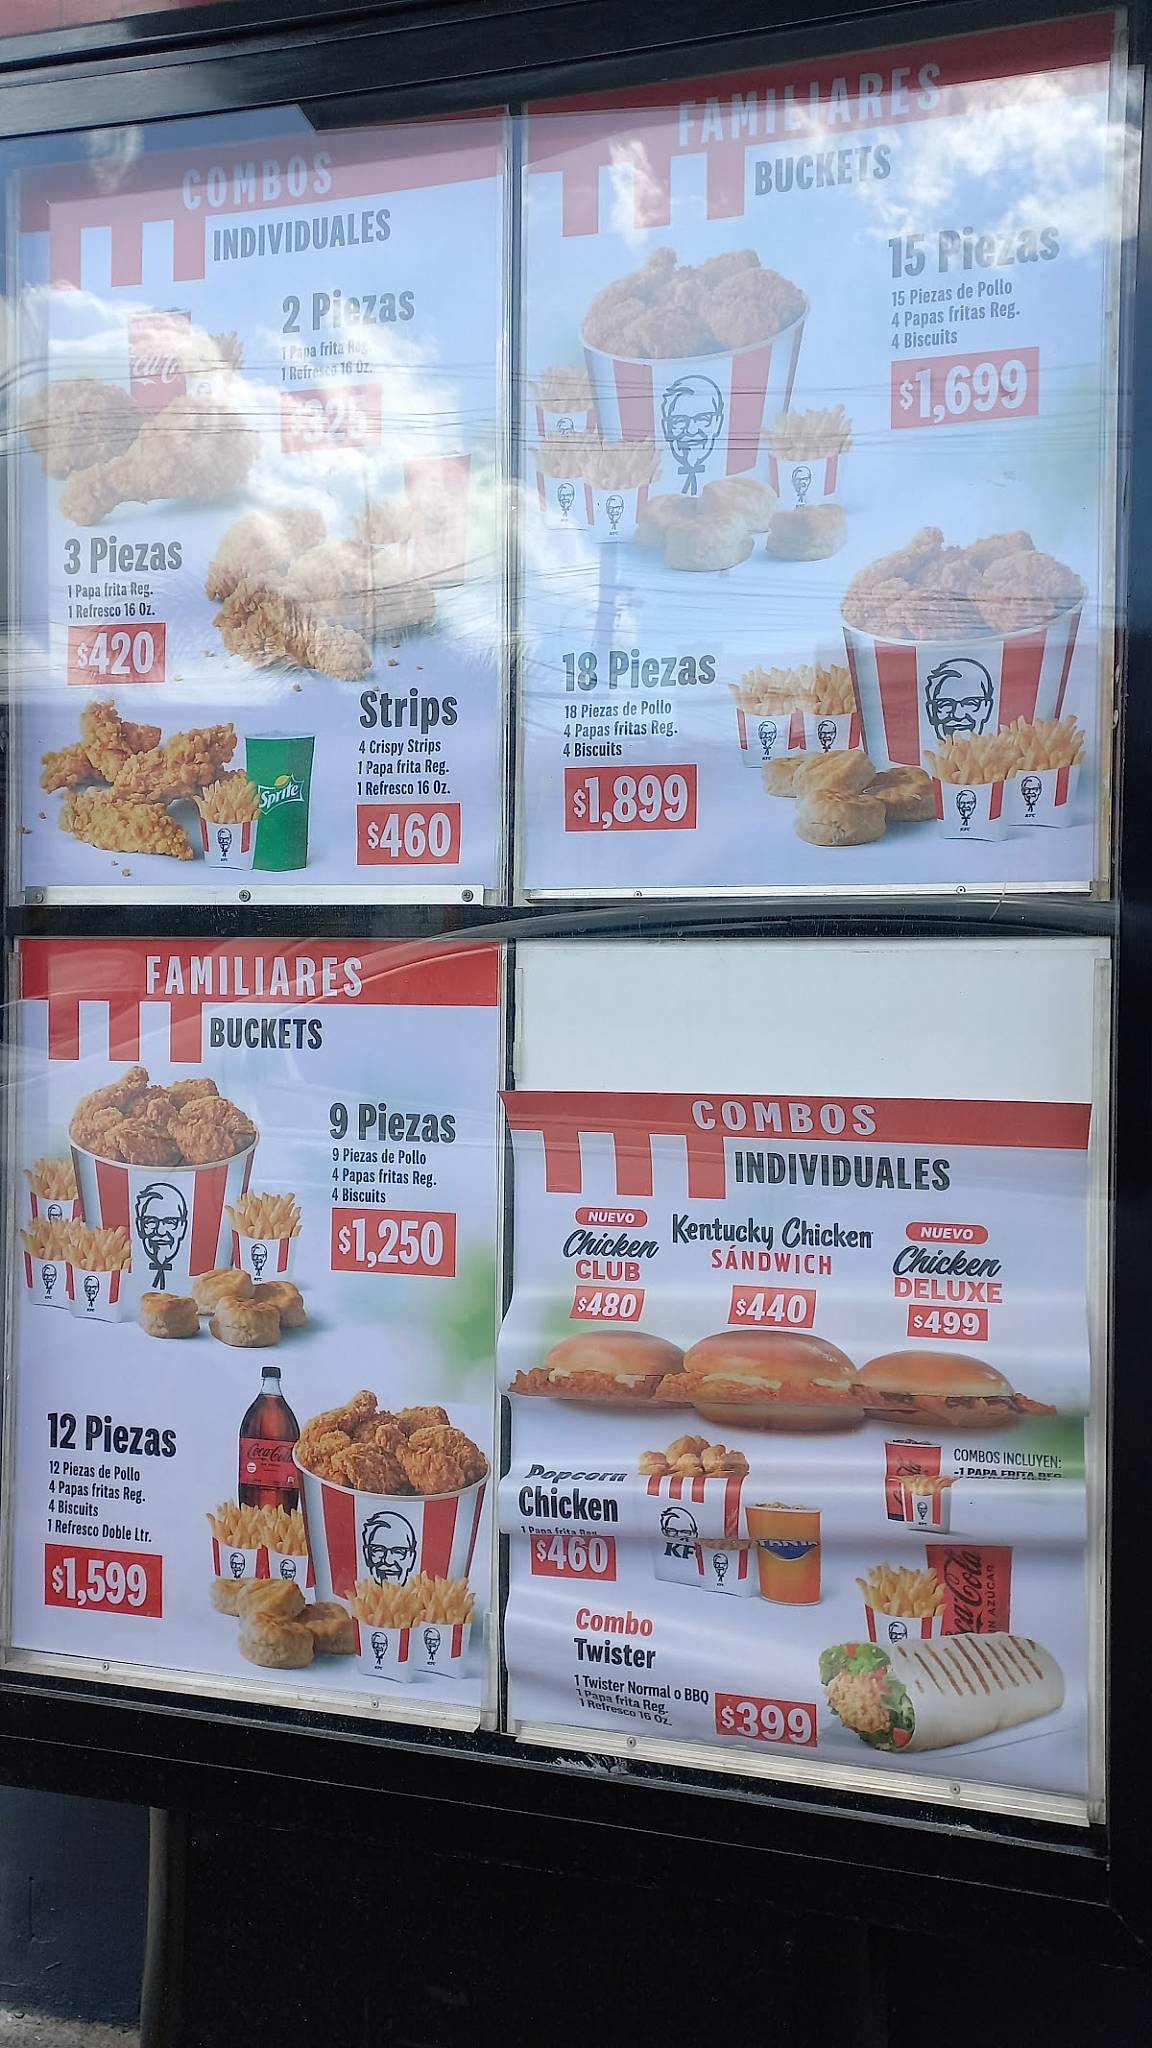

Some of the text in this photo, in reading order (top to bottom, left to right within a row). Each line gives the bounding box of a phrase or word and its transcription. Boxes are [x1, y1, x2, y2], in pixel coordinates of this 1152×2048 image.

[679, 62, 942, 147] FAMILIARES
[182, 151, 334, 211] COMBOS
[755, 143, 892, 196] BUCKETS
[213, 209, 391, 262] INDIVIDUALES
[888, 226, 1060, 278] 15 Piezas
[892, 278, 1012, 307] 15 Piezas de Pollo
[282, 289, 415, 334] 2 Piezas
[891, 301, 1021, 329] 4 Papas fritas Reg.
[320, 341, 344, 356] frita
[891, 329, 957, 349] 4 Biscuits
[281, 367, 286, 381] 1
[340, 361, 353, 374] 16
[900, 359, 1028, 424] $1,699
[64, 535, 182, 574] 3 Piezas
[68, 581, 154, 600] 1 Papa frita Reg.
[68, 606, 73, 619] 1
[76, 603, 121, 619] Refresco
[124, 602, 136, 617] 16
[77, 631, 155, 675] $420
[562, 649, 716, 692] 18 Piezas
[359, 687, 458, 735] Strips
[564, 700, 672, 719] 18 Piezas de Pollo
[564, 720, 678, 740] 4 Papas fritas Reg.
[359, 738, 441, 756] 4 Crispy Strips
[563, 741, 622, 757] 4 Biscuits
[358, 759, 449, 777] 1 Papa frita Reg.
[259, 784, 299, 809] Sprite
[357, 781, 362, 796] 1
[365, 781, 414, 796] Refresco
[417, 780, 429, 795] 16
[573, 773, 688, 830] $1,899
[367, 812, 451, 858] $460
[146, 954, 363, 998] FAMILIARES
[209, 1017, 323, 1049] BUCKETS
[329, 1102, 456, 1143] 9 Piezas
[691, 1099, 877, 1137] COMBOS
[332, 1147, 427, 1165] 9 Piezas de Pollo
[331, 1168, 437, 1188] 4 Papas fritas Reg.
[734, 1151, 951, 1192] INDIVIDUALES
[331, 1187, 386, 1204] 4 Biscuits
[588, 1211, 635, 1224] NUEVO
[672, 1213, 873, 1251] Kentucky Chicken
[338, 1217, 444, 1268] $1,250
[562, 1228, 660, 1259] Chicken
[920, 1226, 974, 1240] NUEVO
[576, 1259, 641, 1282] CLUB
[711, 1244, 832, 1275] SÁNDWICH
[892, 1245, 1002, 1278] Chicken
[577, 1292, 637, 1318] $480
[894, 1277, 1003, 1304] DELUXE
[736, 1292, 808, 1323] $440
[913, 1310, 980, 1336] $499
[47, 1412, 177, 1458] 12 Piezas
[49, 1460, 140, 1481] 12 Piezas de Pollo
[954, 1448, 1062, 1469] COMBOS INCLUYEN:
[524, 1464, 628, 1484] Popcorn
[48, 1480, 146, 1504] 4 Papas fritas Reg.
[519, 1485, 619, 1522] Chicken
[48, 1498, 99, 1517] 4 Biscuits
[47, 1518, 152, 1543] 1 Refresco Doble Ltr.
[536, 1535, 608, 1574] $460
[51, 1556, 148, 1607] $1,599
[576, 1607, 654, 1637] Combo
[574, 1637, 657, 1670] Twister
[574, 1675, 709, 1706] 1 Twister Normal o BBQ
[576, 1689, 669, 1715] 1 Papa frita Reg.
[580, 1698, 585, 1707] 1
[588, 1700, 637, 1718] Refresco
[639, 1710, 651, 1721] 16
[721, 1701, 812, 1744] $399
